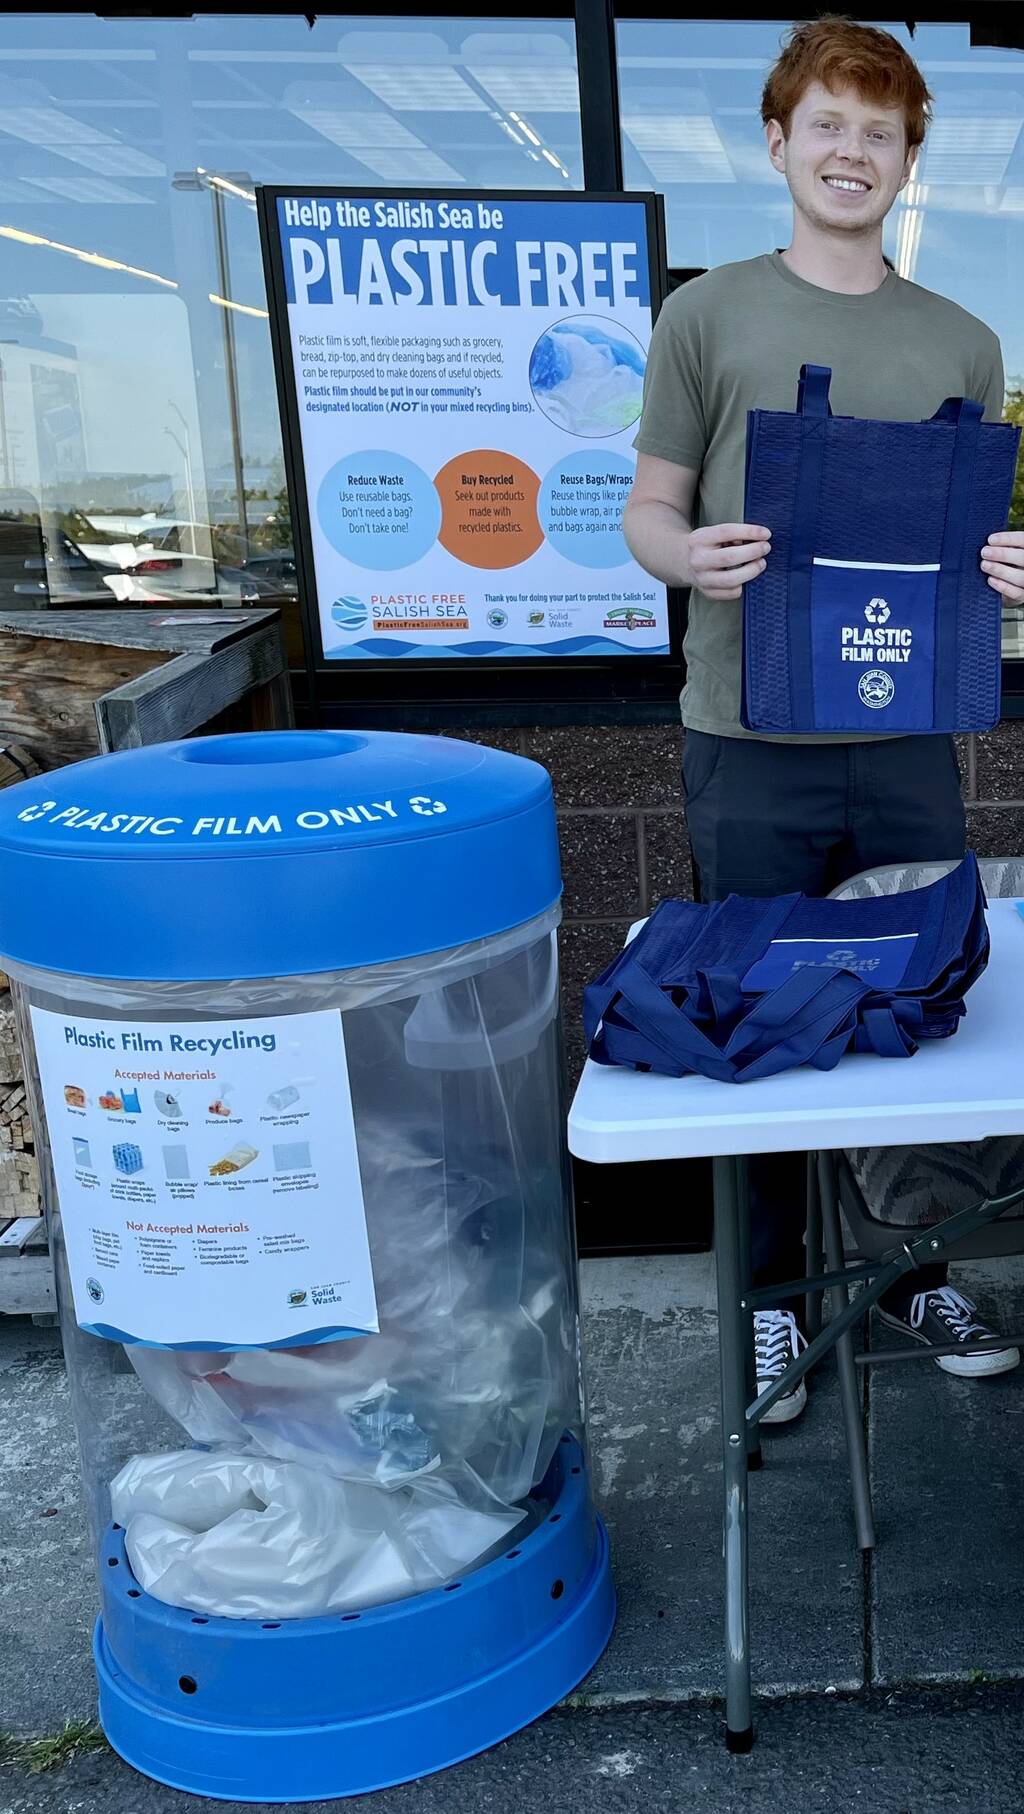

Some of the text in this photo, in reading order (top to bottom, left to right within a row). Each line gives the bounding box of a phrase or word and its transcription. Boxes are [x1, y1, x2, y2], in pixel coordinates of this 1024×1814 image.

[284, 200, 502, 230] Help the Salish Sea be
[289, 237, 641, 308] PLASTIC FREE
[299, 335, 503, 348] Plastic film is soft, flexible packaging such as grocery,
[304, 386, 330, 396] Plastic
[332, 386, 348, 395] film
[350, 385, 376, 396] should
[378, 386, 388, 396] be
[390, 386, 403, 397] put
[406, 386, 413, 396] in
[415, 388, 428, 396] our
[306, 401, 350, 413] designated
[352, 402, 383, 411] location
[386, 401, 419, 413] (NOT
[420, 402, 428, 411] in
[430, 404, 447, 413] your
[450, 401, 474, 411] mixed
[476, 402, 510, 413] recycling
[348, 475, 403, 485] Reduce Waste
[462, 474, 513, 486] Buy Recycled
[560, 473, 633, 486] Reuse Bags/Wraps
[339, 491, 412, 503] Use reusable bags.
[454, 490, 524, 503] Seek out products
[365, 506, 385, 517] need
[387, 508, 392, 517] a
[394, 506, 412, 518] bag?
[469, 506, 510, 516] made with
[372, 523, 389, 533] take
[391, 522, 408, 533] one!
[458, 522, 522, 534] recycled plastics.
[371, 594, 466, 605] PLASTIC FREE
[372, 606, 469, 618] SALISH SEA
[841, 627, 912, 647] PLASTIC
[841, 647, 912, 663] FILM ONLY
[49, 799, 399, 836] PLASTIC FILM ONLY
[64, 1026, 277, 1057] Plastic Film Recycling
[114, 1068, 217, 1082] Accepted Materials
[126, 1220, 250, 1235] Not Accepted Materials
[311, 1288, 335, 1299] Solid
[312, 1294, 342, 1306] Waste
